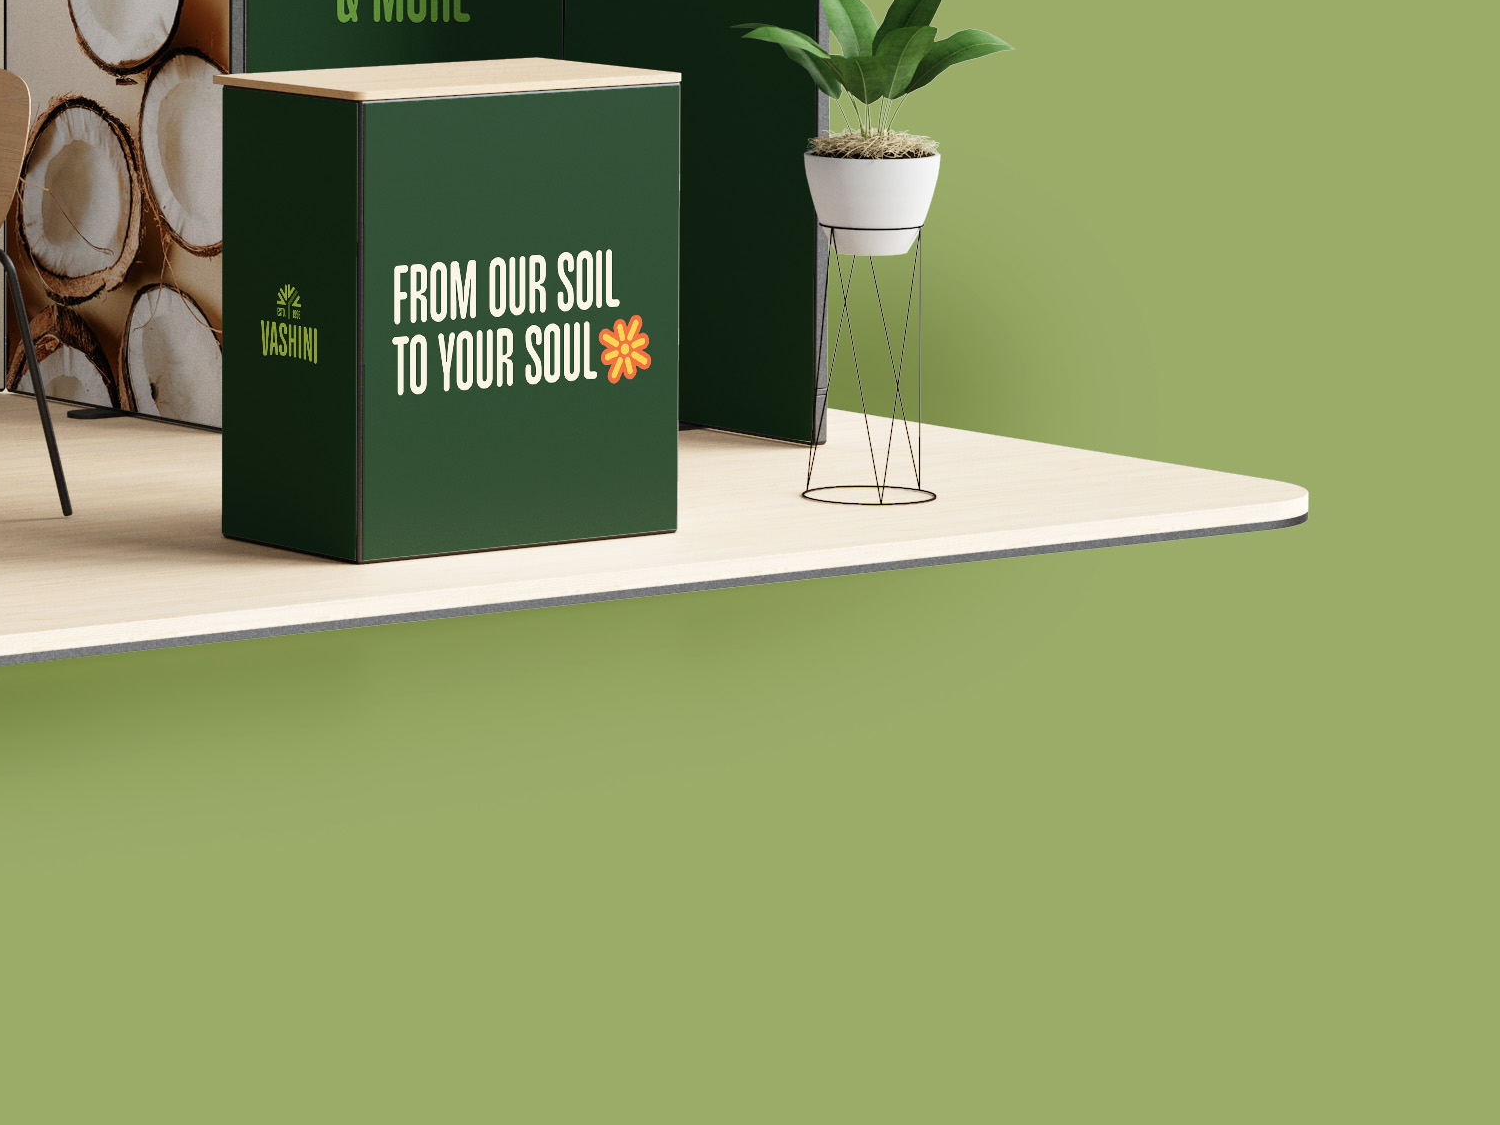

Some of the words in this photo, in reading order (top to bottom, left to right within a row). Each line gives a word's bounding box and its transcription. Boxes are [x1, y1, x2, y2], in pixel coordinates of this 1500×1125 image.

[394, 260, 477, 325] FROM
[489, 254, 547, 318] OUR
[557, 249, 620, 312] SOIL
[261, 320, 318, 364] VASHINI
[392, 335, 428, 396] TO
[438, 328, 514, 392] YOUR
[525, 321, 598, 385] SOUL
